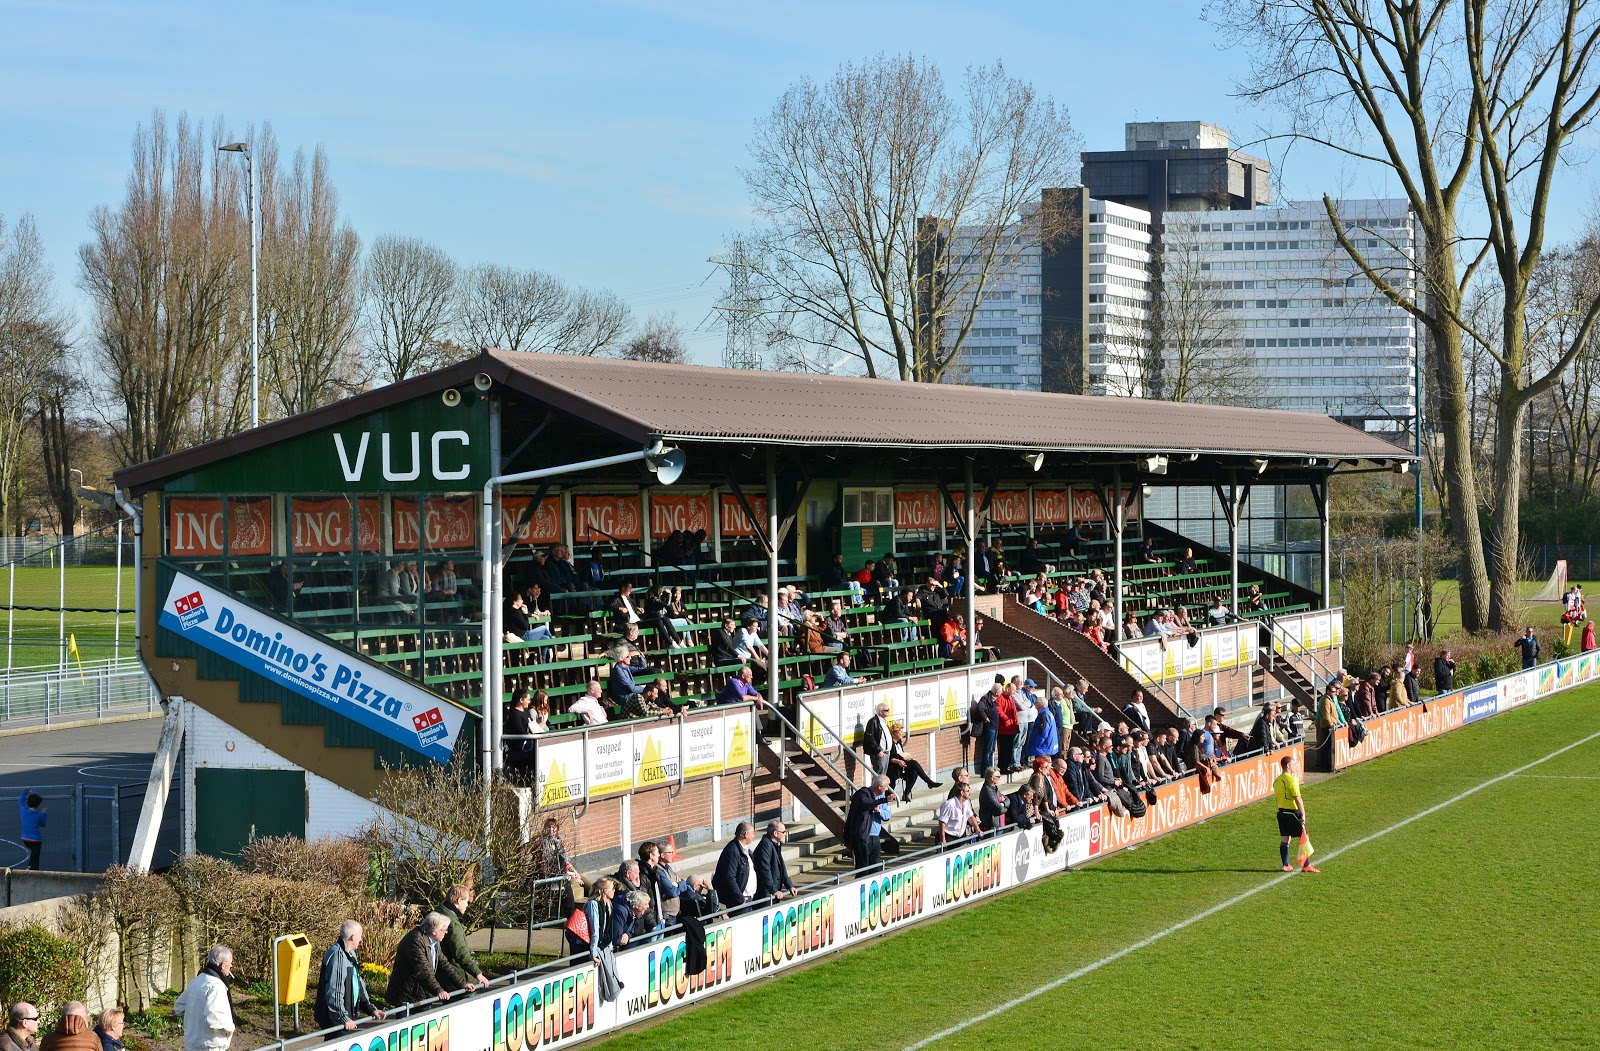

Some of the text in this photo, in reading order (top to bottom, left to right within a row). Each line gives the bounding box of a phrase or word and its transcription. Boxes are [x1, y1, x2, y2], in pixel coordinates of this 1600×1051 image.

[333, 430, 471, 482] VUC
[578, 505, 614, 537] ING
[654, 504, 686, 534] ING
[897, 501, 921, 525] ING
[993, 498, 1012, 521] ING
[1034, 497, 1053, 520] ING
[1073, 497, 1091, 519] ING
[294, 511, 342, 547] ING
[398, 510, 441, 544] ING
[180, 608, 205, 622] Domino's
[183, 618, 199, 629] Pizza
[214, 606, 328, 682] Domino's
[264, 663, 340, 704] www.dominospizza.nl
[419, 724, 444, 739] Domino's
[691, 724, 713, 738] vastgoed
[1418, 711, 1432, 738] ING
[1441, 704, 1455, 731] ING
[421, 734, 438, 746] Pizza
[1365, 727, 1382, 756] ING
[1392, 718, 1408, 747] ING
[596, 740, 622, 755] vastgoed
[643, 763, 678, 782] CHATENIER
[1233, 769, 1256, 805] ING
[1150, 794, 1177, 834] ING
[1103, 809, 1132, 850] ING
[932, 892, 945, 909] VAN
[945, 841, 1001, 905] LOCHEM
[844, 866, 924, 939] VAN LOCHEM
[744, 893, 834, 975] VAN LOCHEM
[627, 926, 732, 1016] VAN LOCEM
[493, 969, 595, 1051] LOCHEM
